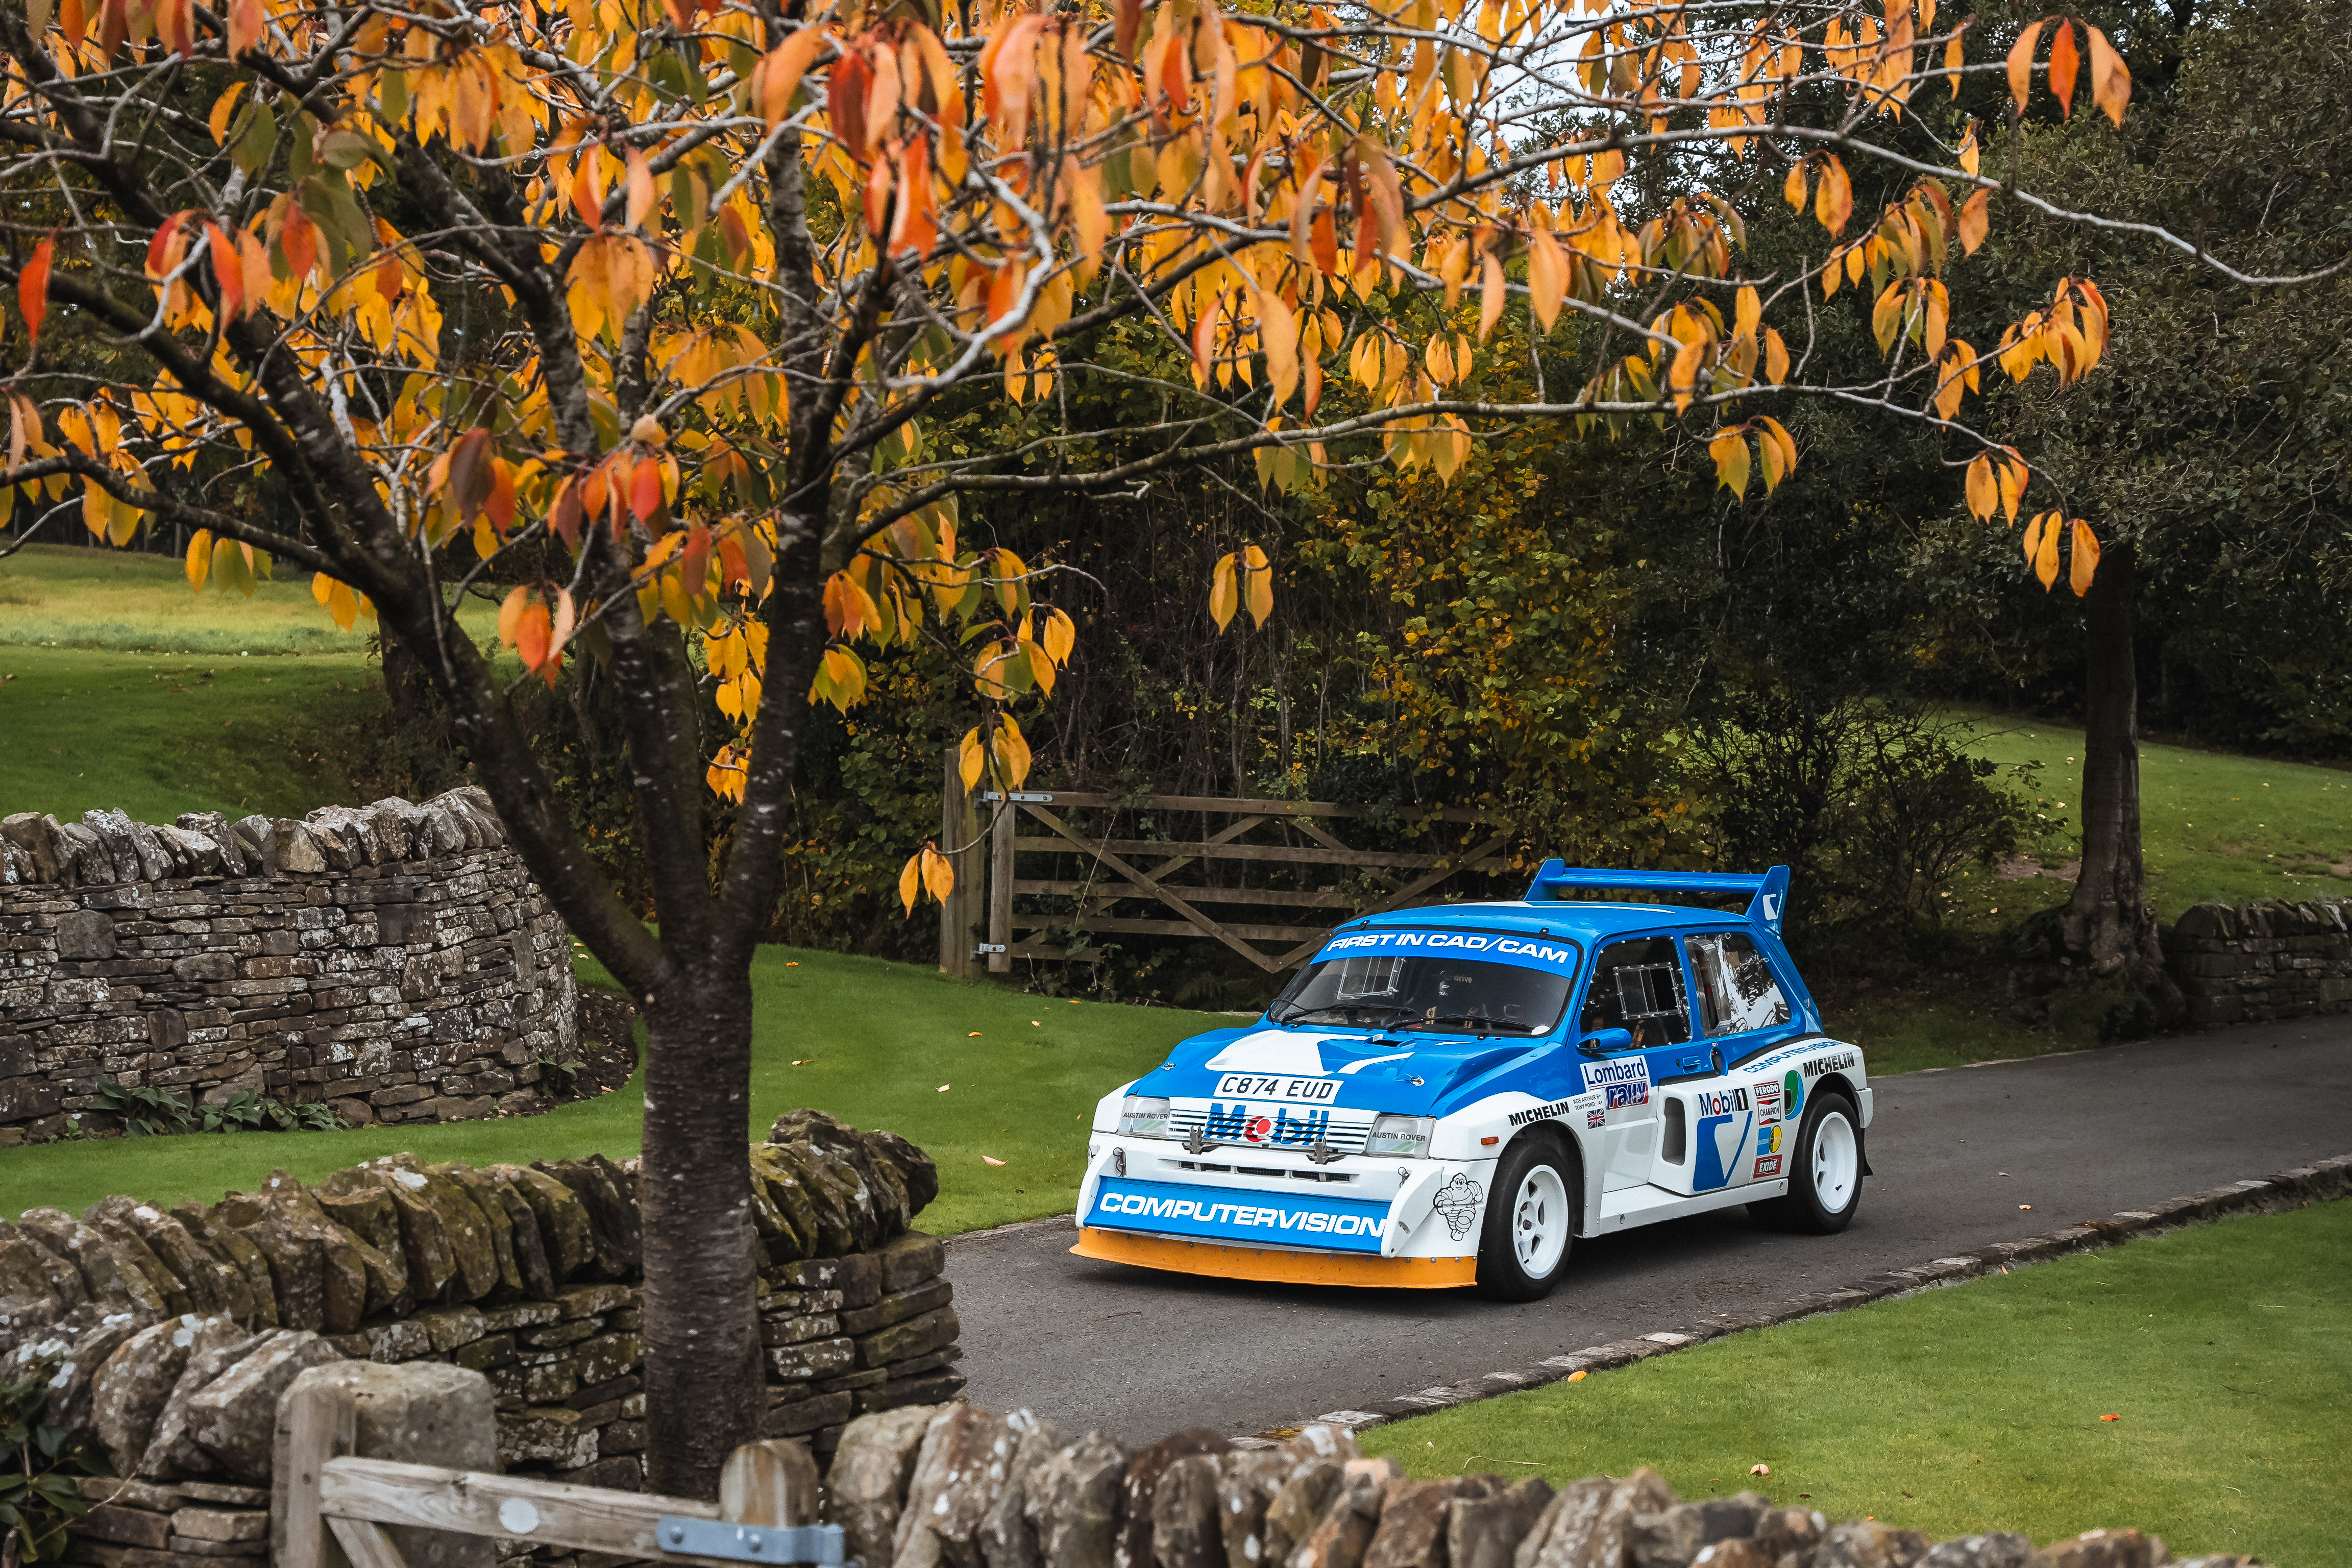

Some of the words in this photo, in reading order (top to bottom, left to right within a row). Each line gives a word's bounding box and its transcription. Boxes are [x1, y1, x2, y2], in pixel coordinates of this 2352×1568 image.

[1327, 934, 1396, 952] FIRST
[1396, 934, 1426, 946] IN
[1426, 935, 1569, 964] CAD/CAM
[1742, 1041, 1844, 1073] COMPUTERVISION
[1802, 1052, 1855, 1078] MICHELIN
[1583, 1057, 1646, 1085] Lombard
[1222, 1076, 1279, 1095] C874
[1286, 1080, 1334, 1099] EUD
[1608, 1081, 1647, 1109] rally
[1755, 1084, 1779, 1096] FERODO
[1508, 1101, 1570, 1126] MICHELIN
[1698, 1089, 1738, 1116] Mobil
[1760, 1106, 1779, 1117] CHAMPION
[1203, 1102, 1329, 1145] Mobil
[1400, 1134, 1426, 1142] ROVER
[1758, 1159, 1777, 1173] EXIDE
[1099, 1192, 1386, 1237] COMPUTERVISION
